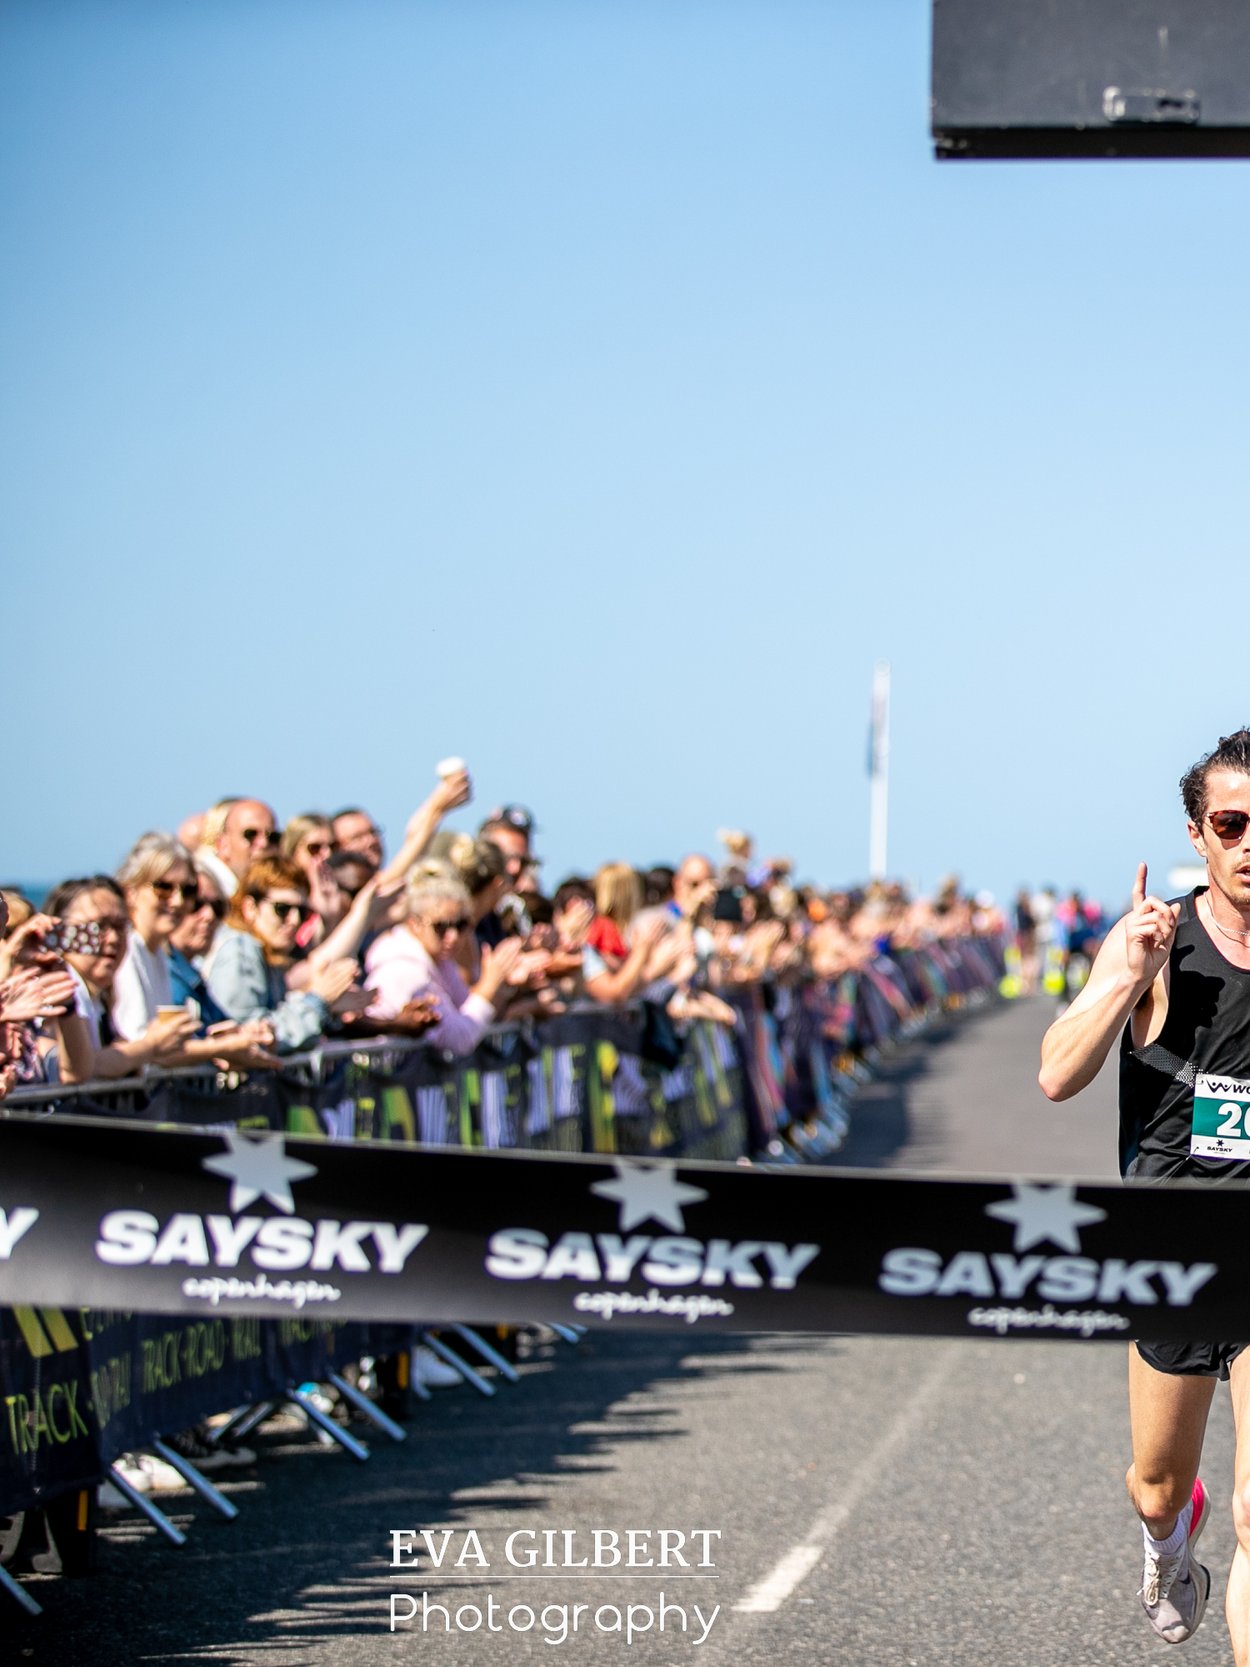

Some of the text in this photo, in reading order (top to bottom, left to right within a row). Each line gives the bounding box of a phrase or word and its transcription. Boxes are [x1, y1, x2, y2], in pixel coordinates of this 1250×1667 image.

[96, 1209, 429, 1274] SAYSKY
[485, 1227, 820, 1290] SAYSKY
[182, 1272, 341, 1308] copenhagen
[878, 1247, 1218, 1307] SAYSKY
[5, 1379, 89, 1455] TRACK
